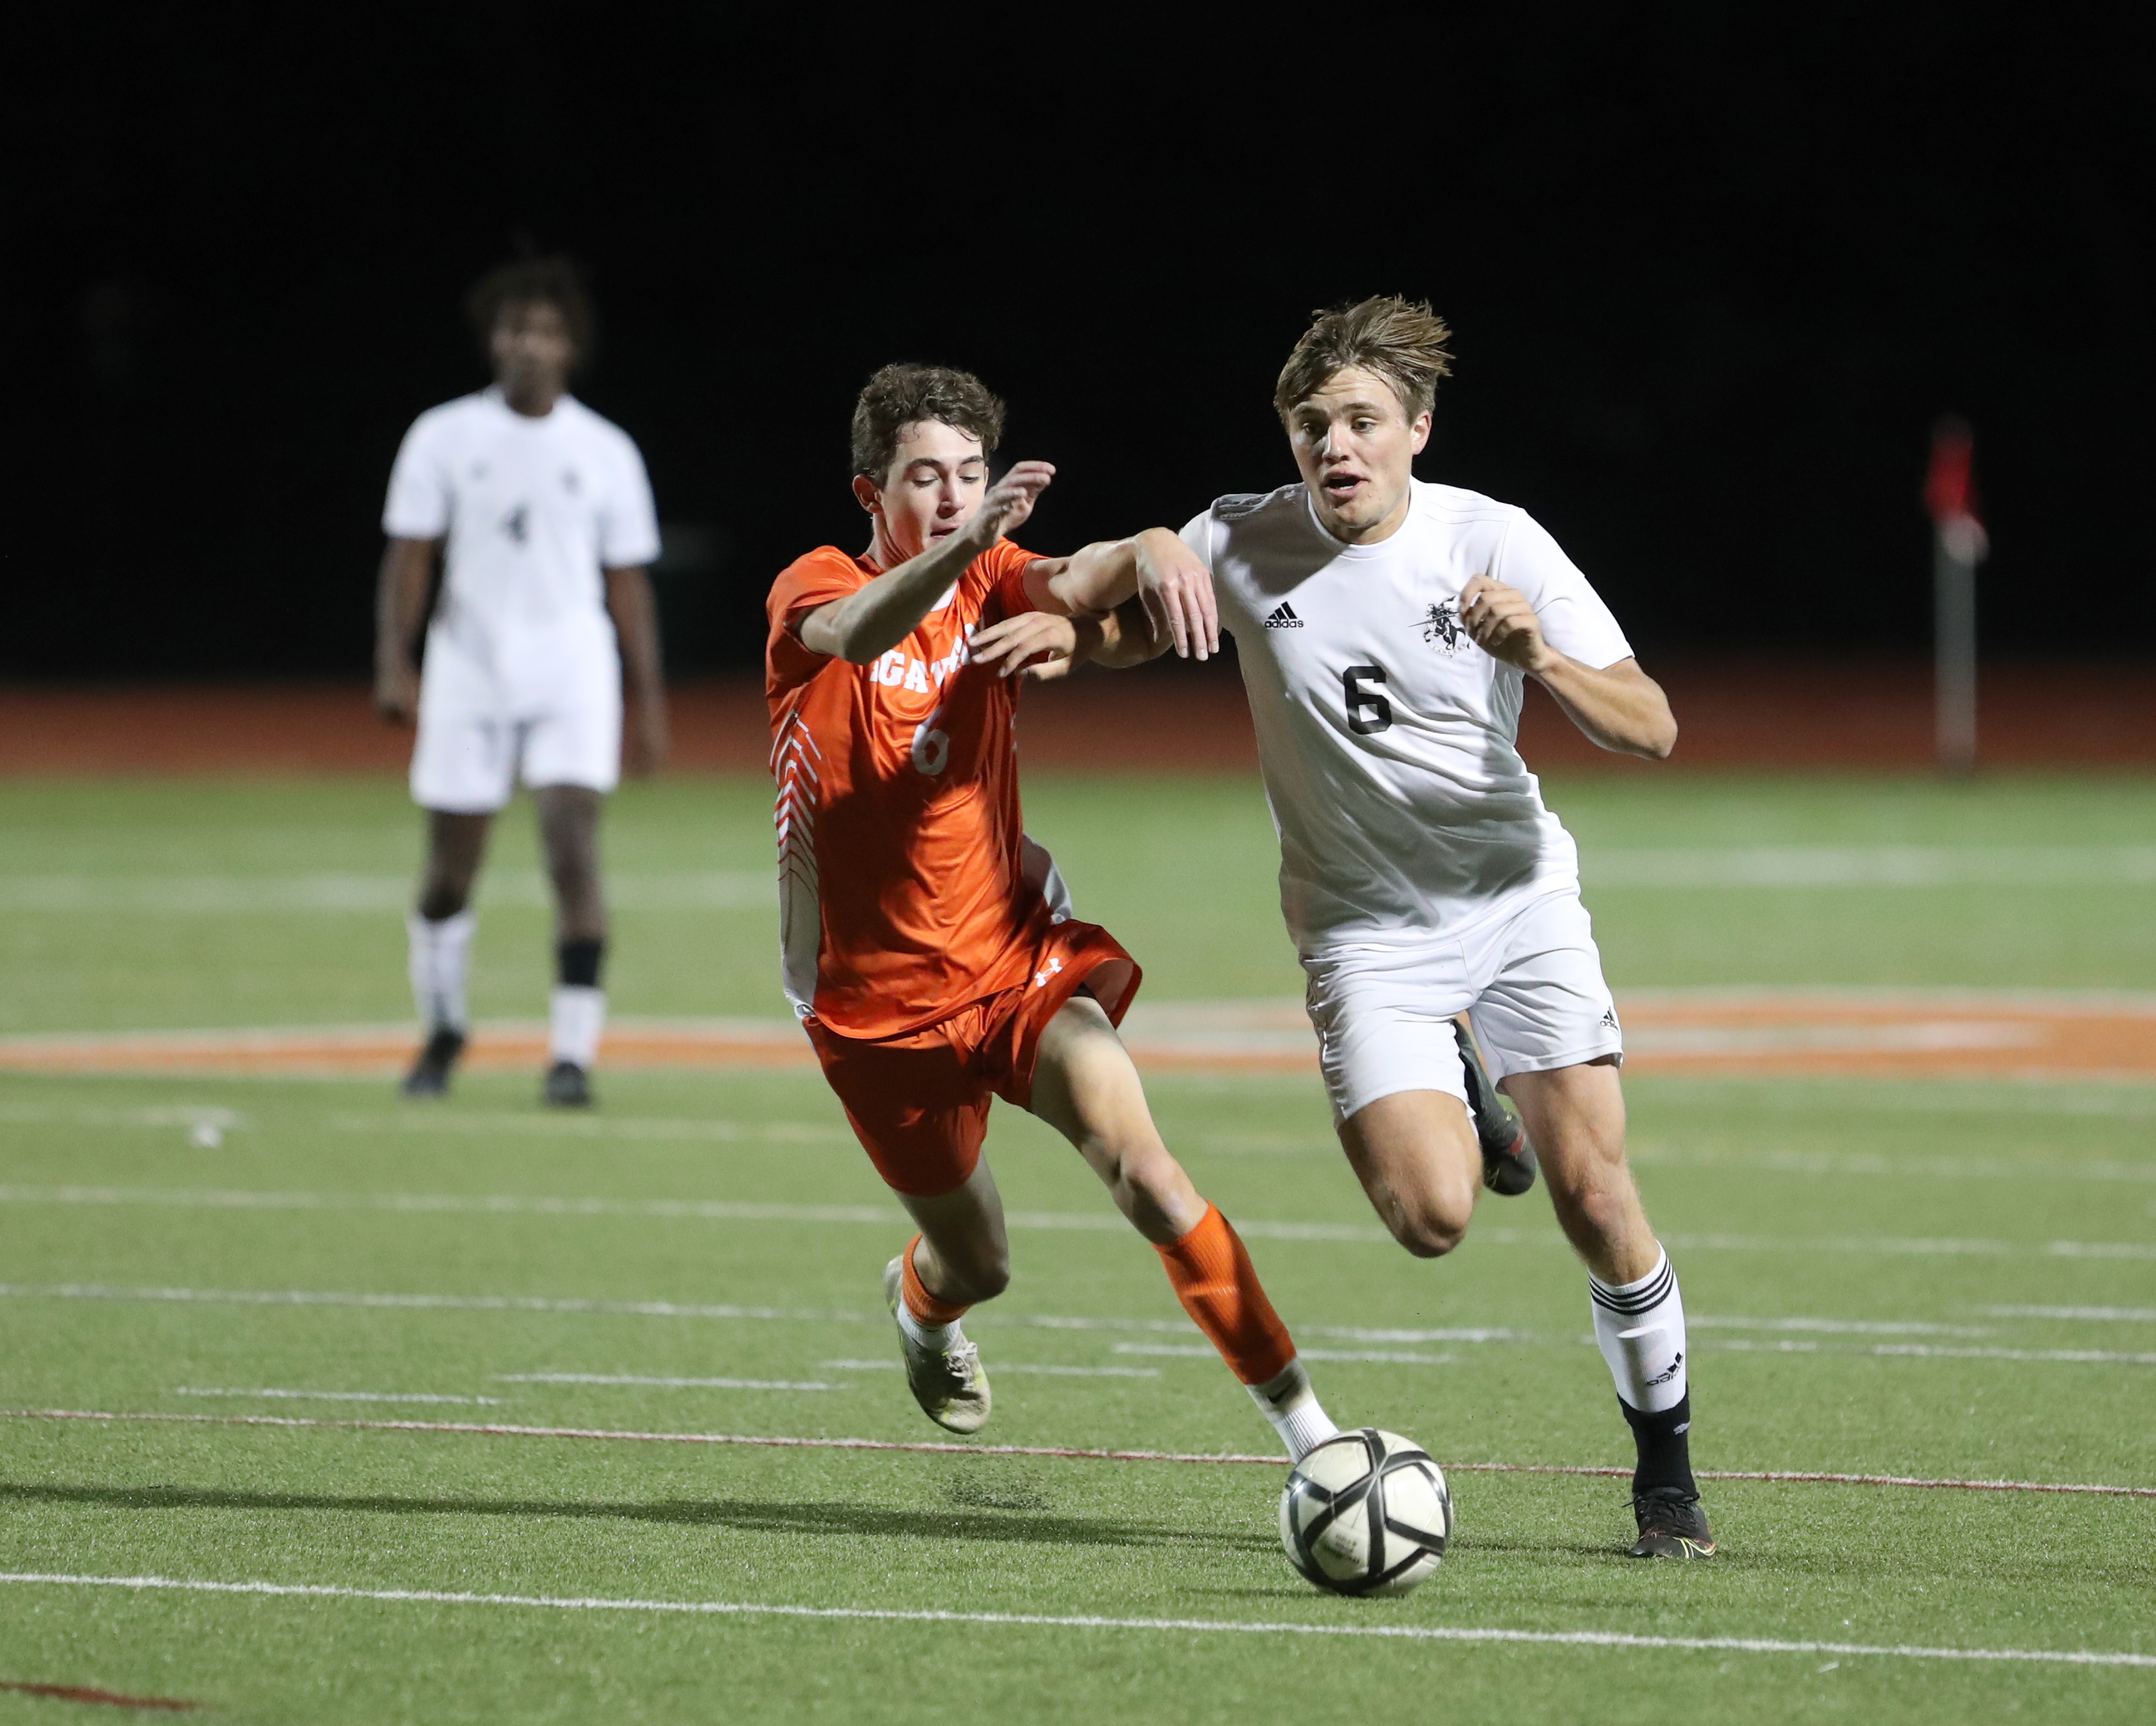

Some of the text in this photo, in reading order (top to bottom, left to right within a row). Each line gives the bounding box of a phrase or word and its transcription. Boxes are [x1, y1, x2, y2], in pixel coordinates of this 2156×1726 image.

[1264, 618, 1304, 628] adidas
[1343, 665, 1392, 735] 6
[910, 707, 950, 776] 6
